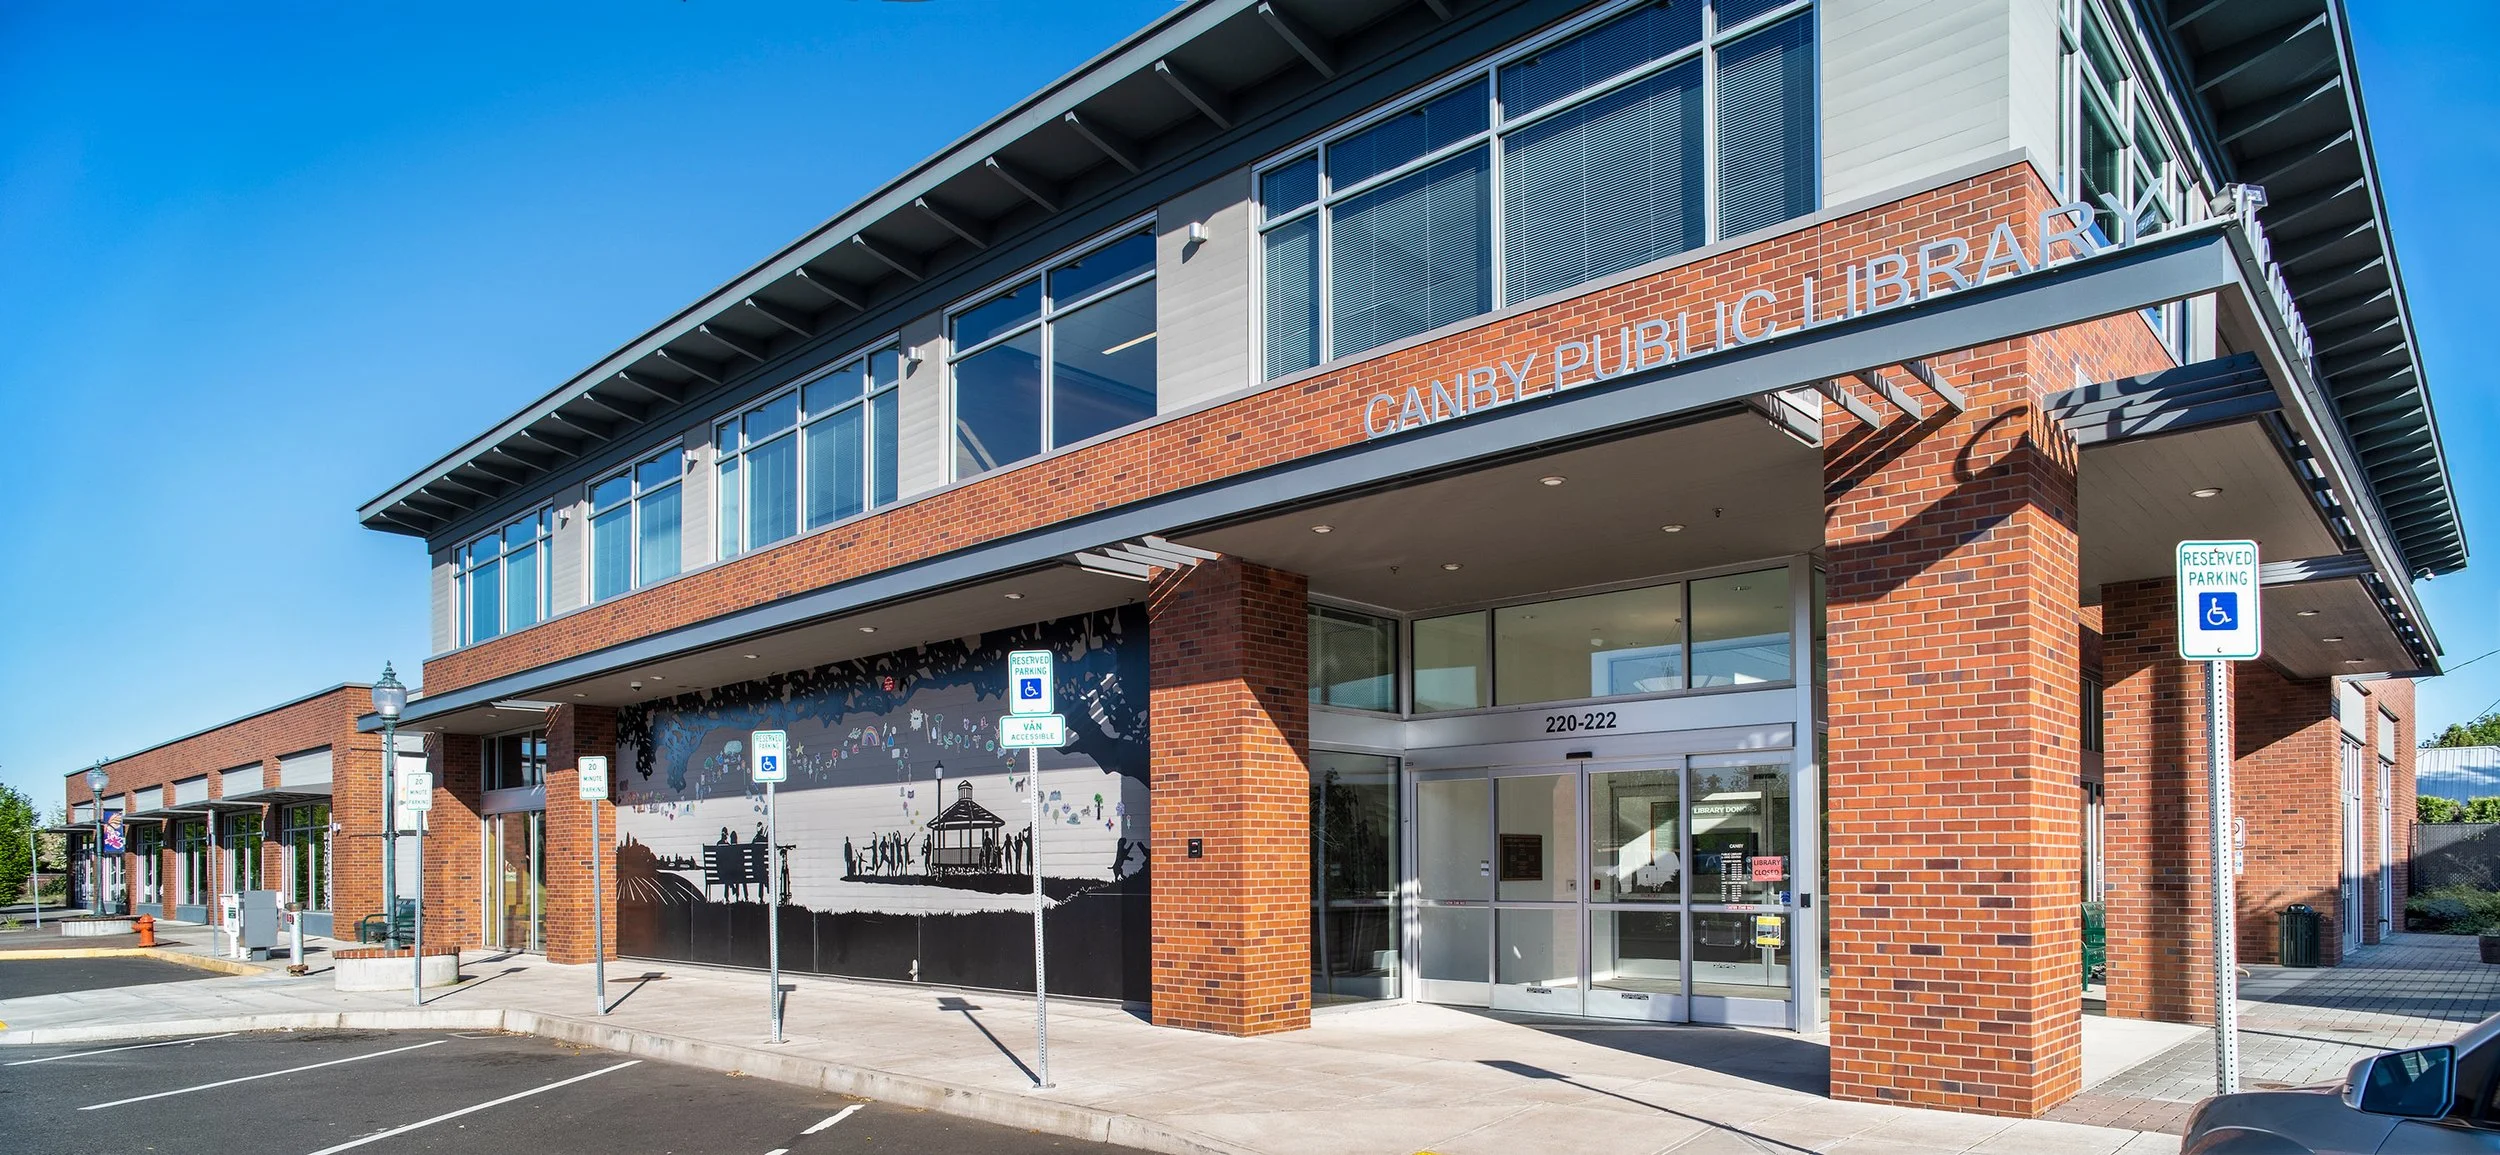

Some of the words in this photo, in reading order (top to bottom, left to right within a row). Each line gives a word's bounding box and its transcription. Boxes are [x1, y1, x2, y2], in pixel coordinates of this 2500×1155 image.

[1363, 352, 1537, 438] CANBY
[1553, 288, 1777, 392] PUBLIC
[1803, 177, 2165, 331] LIBRARY
[2183, 551, 2252, 566] RESERVED
[2189, 571, 2248, 586] PARKING
[1012, 655, 1050, 665] RESERVED
[1015, 667, 1047, 675] PARKING
[1023, 723, 1042, 731] VAN
[1545, 711, 1617, 733] 220-222
[1693, 806, 1724, 814] LIBRARY
